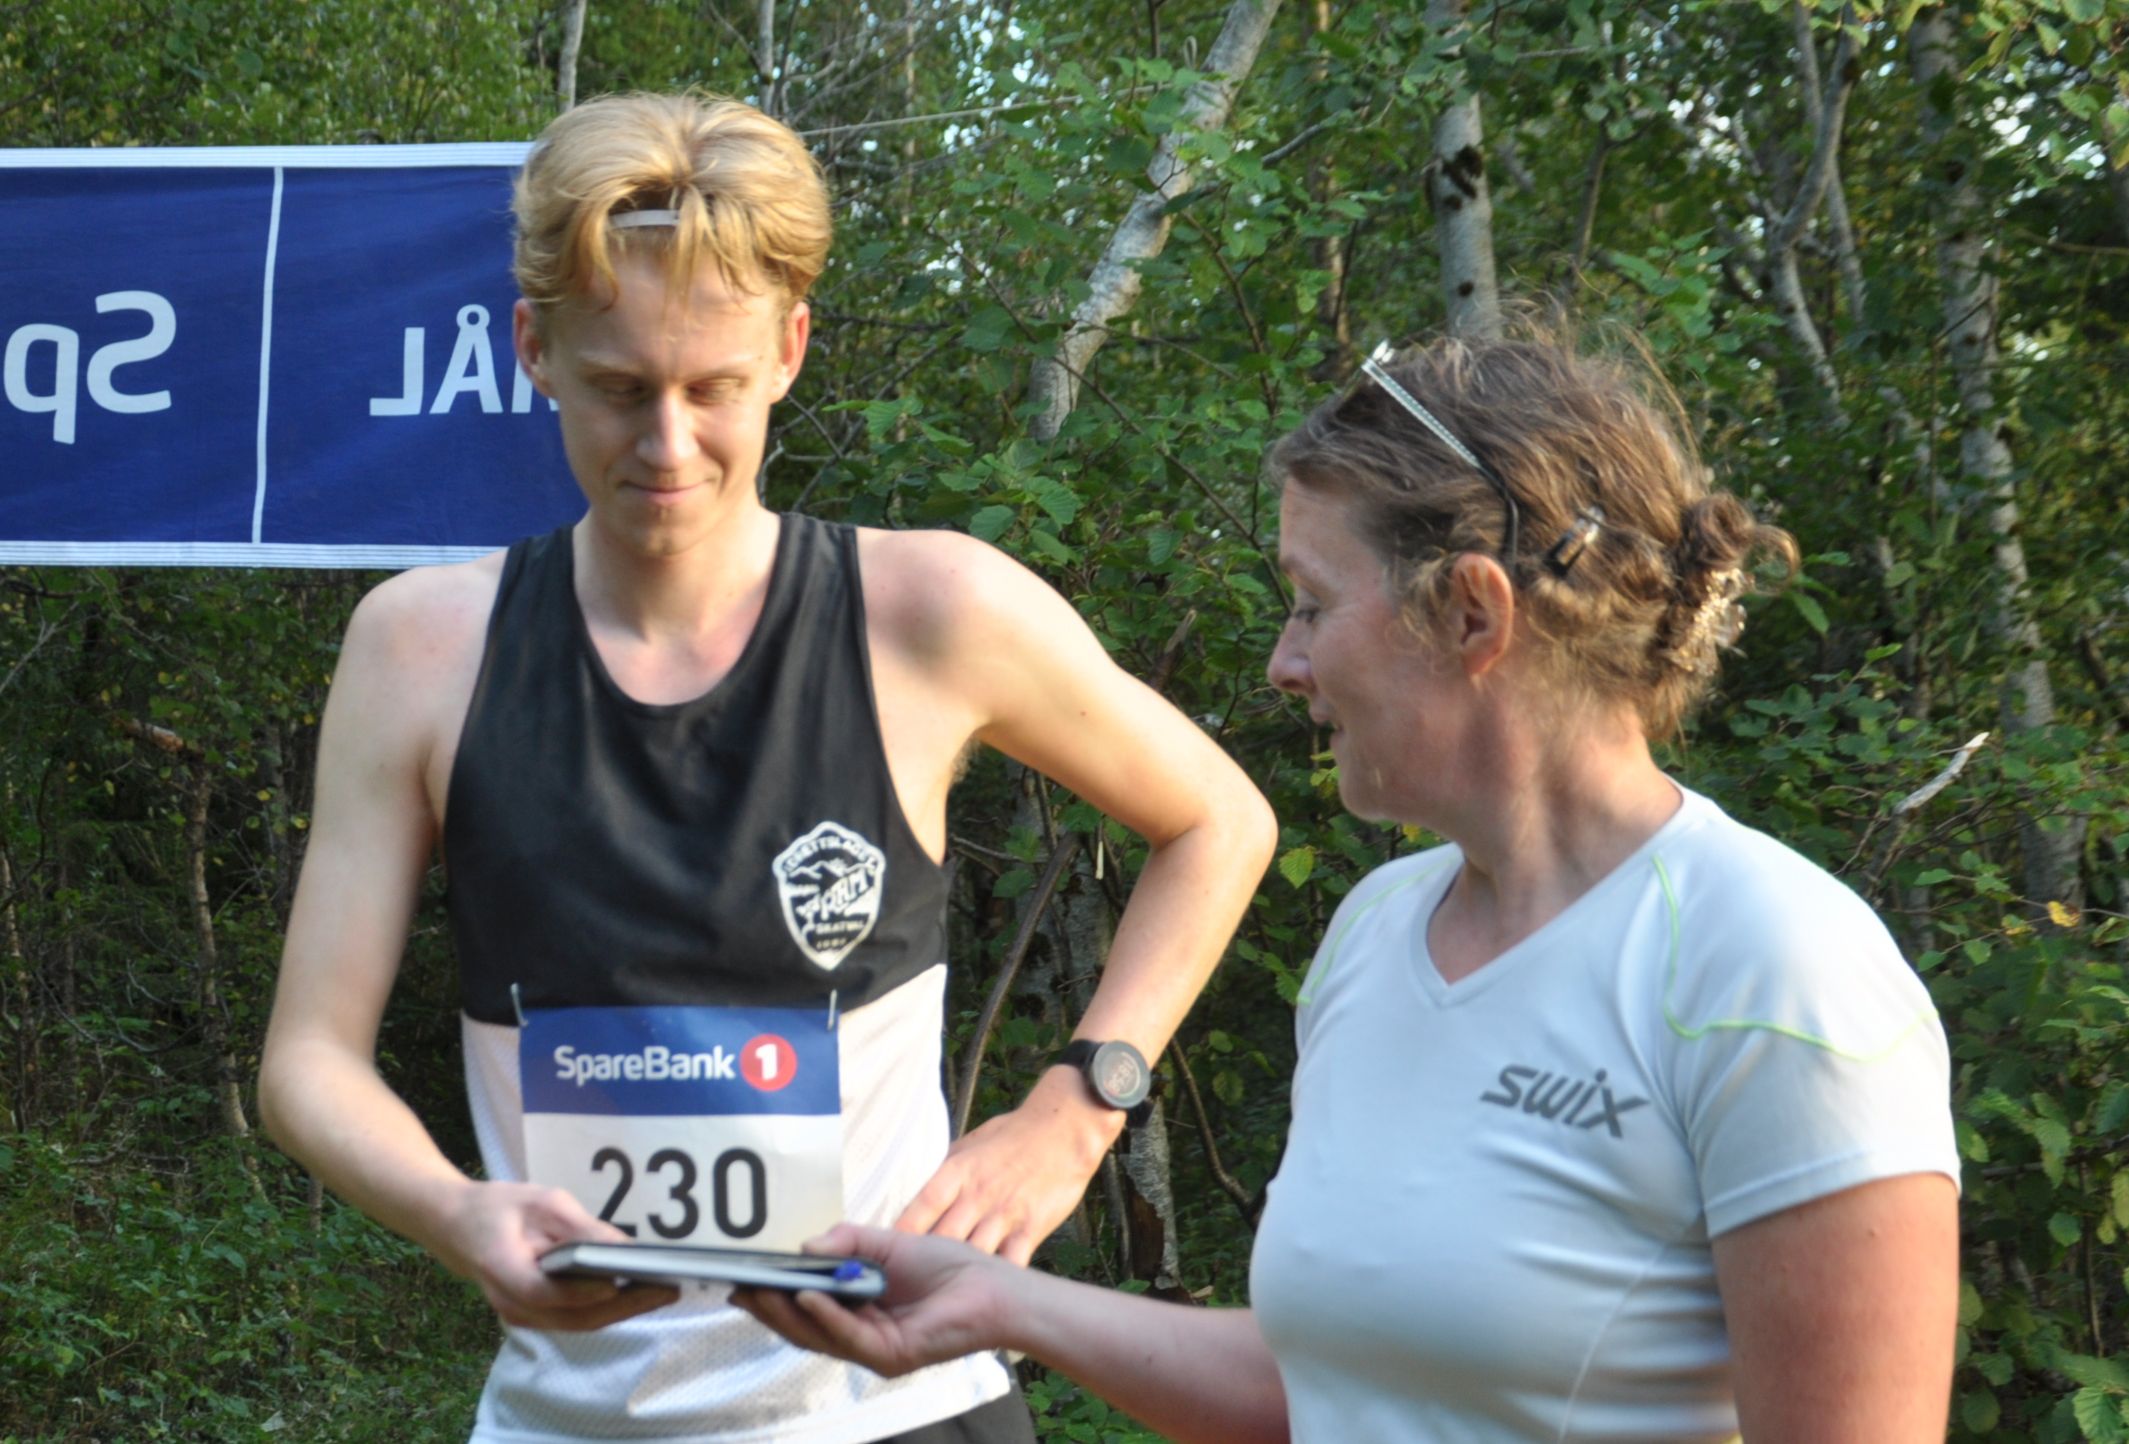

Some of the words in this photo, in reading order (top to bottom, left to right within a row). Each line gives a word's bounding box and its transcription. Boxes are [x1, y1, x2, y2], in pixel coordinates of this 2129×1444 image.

[554, 1045, 735, 1087] SpareBank
[755, 1043, 778, 1081] 1
[590, 1146, 768, 1240] 230
